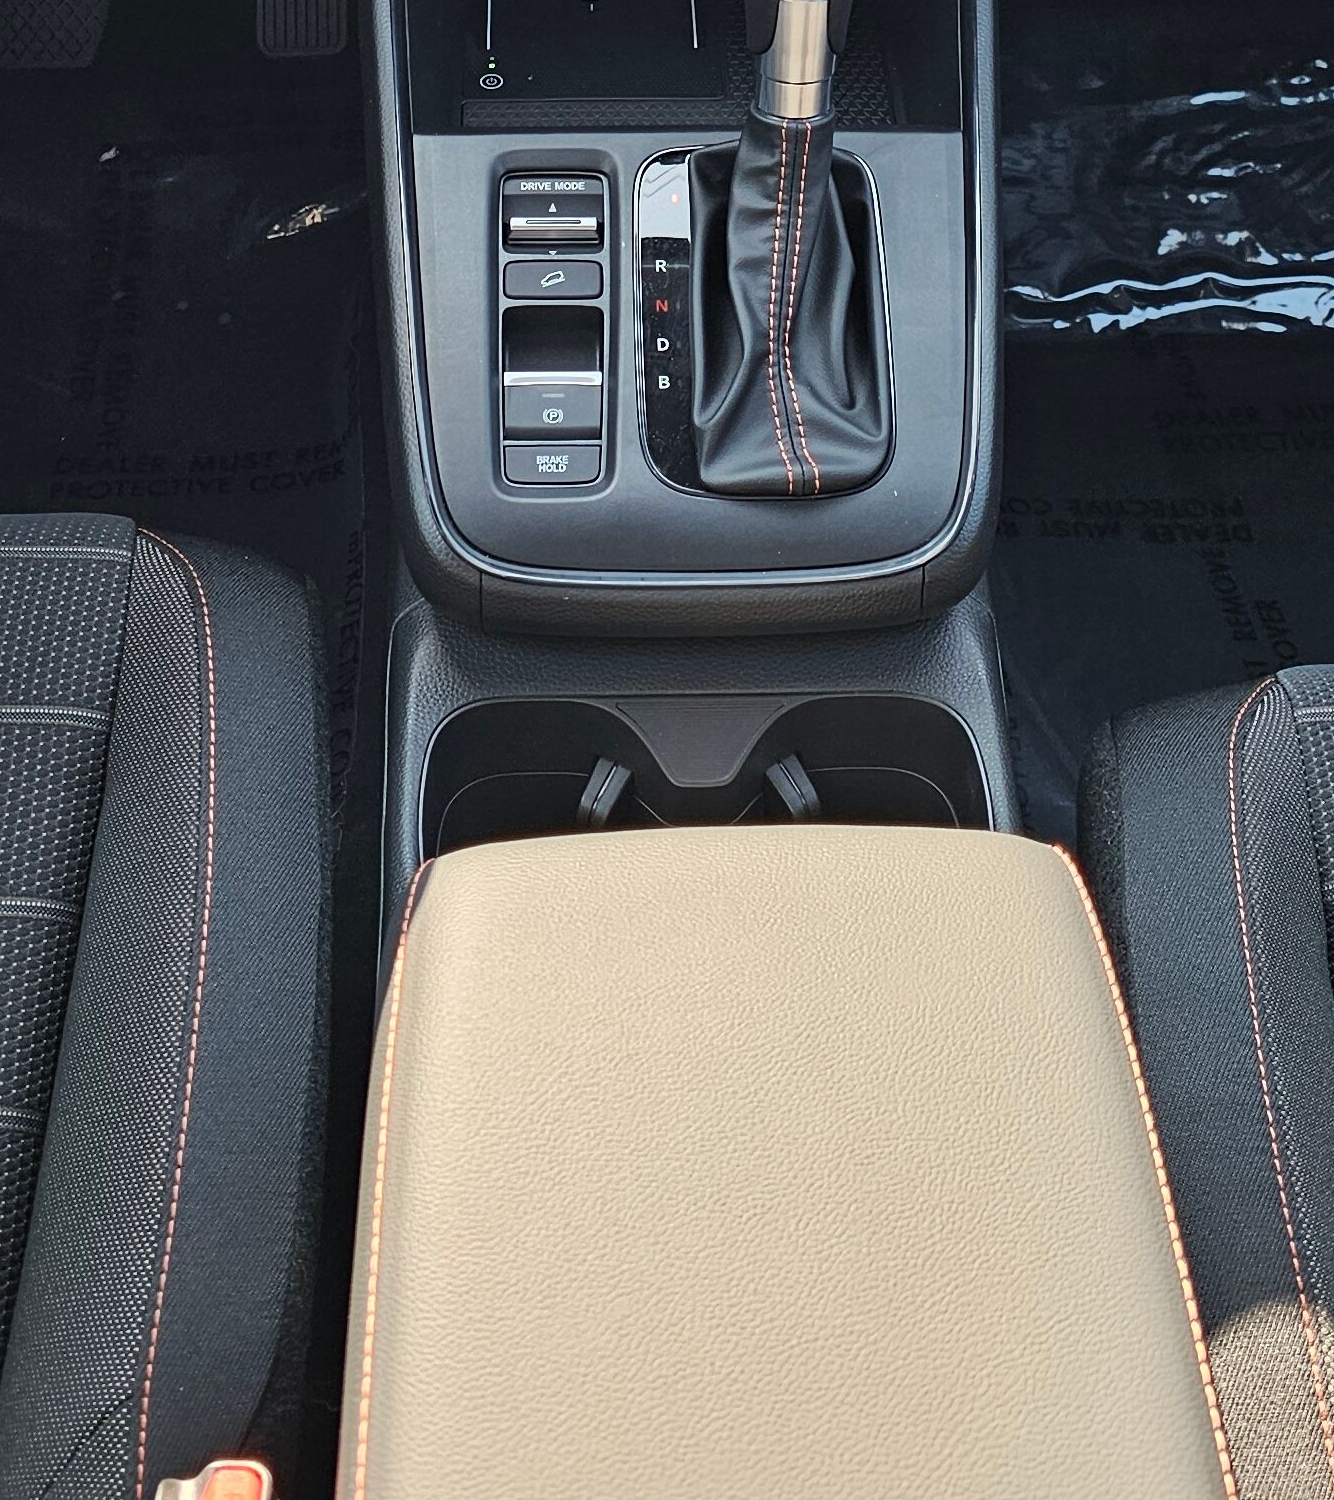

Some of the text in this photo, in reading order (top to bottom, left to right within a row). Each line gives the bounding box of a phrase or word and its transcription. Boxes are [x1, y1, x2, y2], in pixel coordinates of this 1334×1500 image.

[520, 181, 585, 191] DRIVE MODE
[655, 259, 667, 273] R
[655, 299, 668, 312] N
[657, 338, 670, 352] D
[658, 375, 671, 389] B
[536, 455, 569, 465] BRAKE
[538, 463, 567, 473] HOLD
